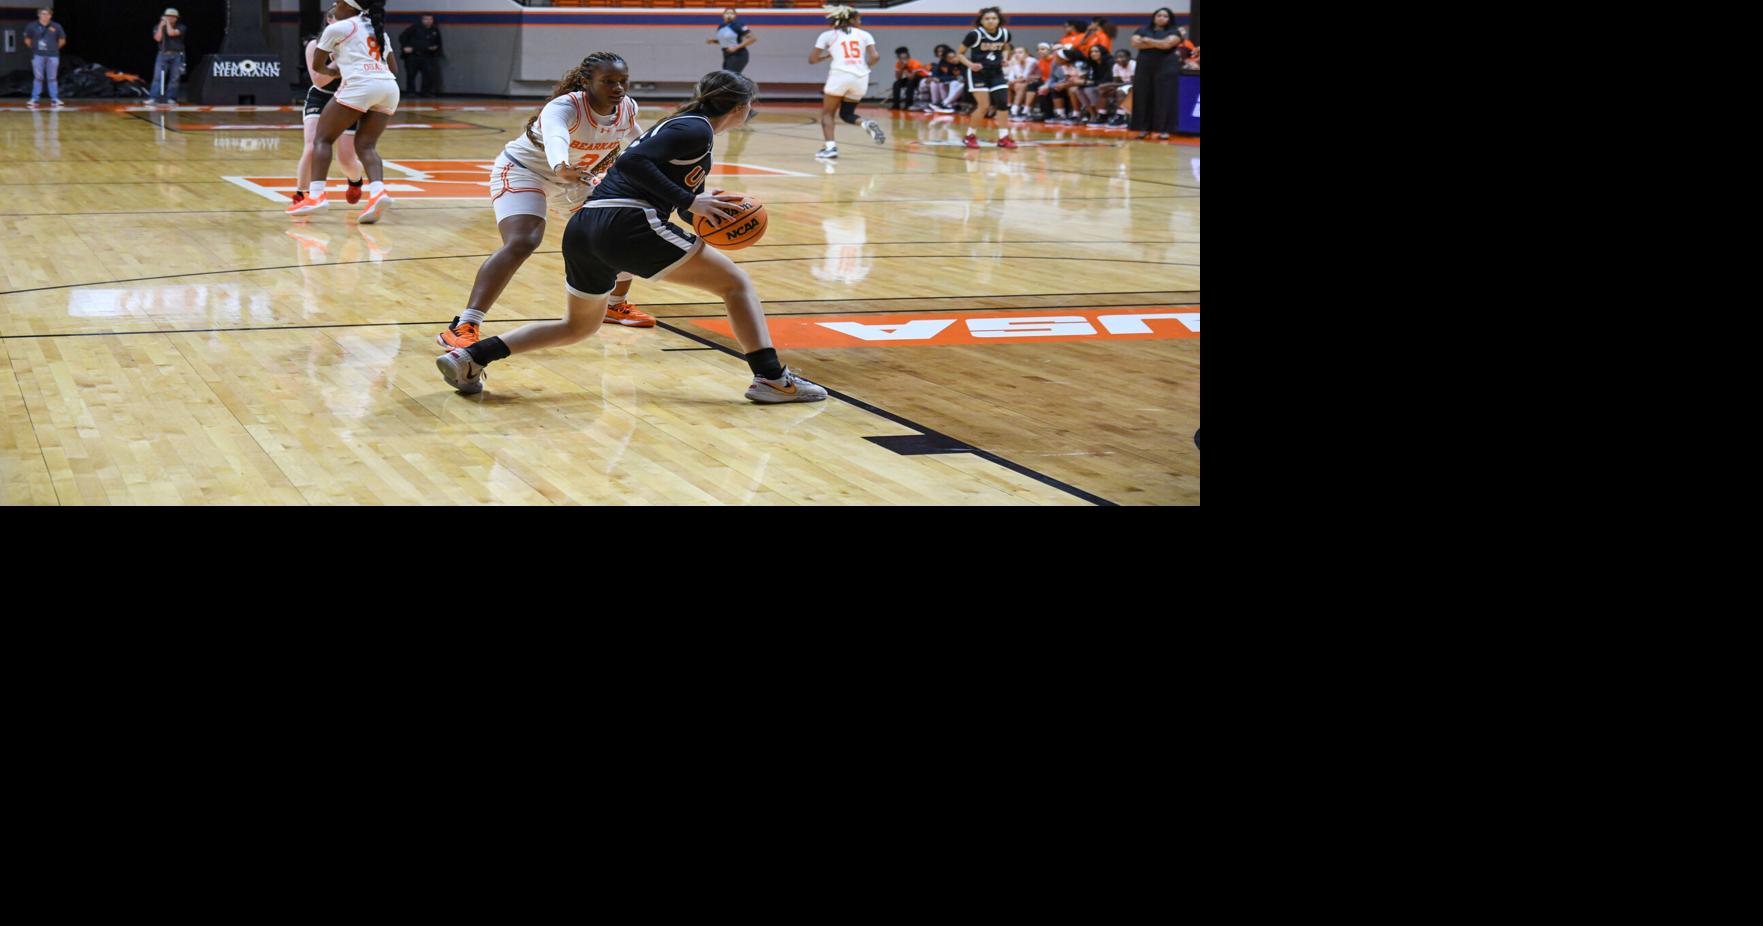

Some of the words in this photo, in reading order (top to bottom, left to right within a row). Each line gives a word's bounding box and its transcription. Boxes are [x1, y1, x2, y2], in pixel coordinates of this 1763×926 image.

[841, 41, 861, 58] 15
[213, 60, 280, 71] MEMORIAL
[213, 68, 280, 77] HERMANN
[726, 218, 759, 240] NCAA
